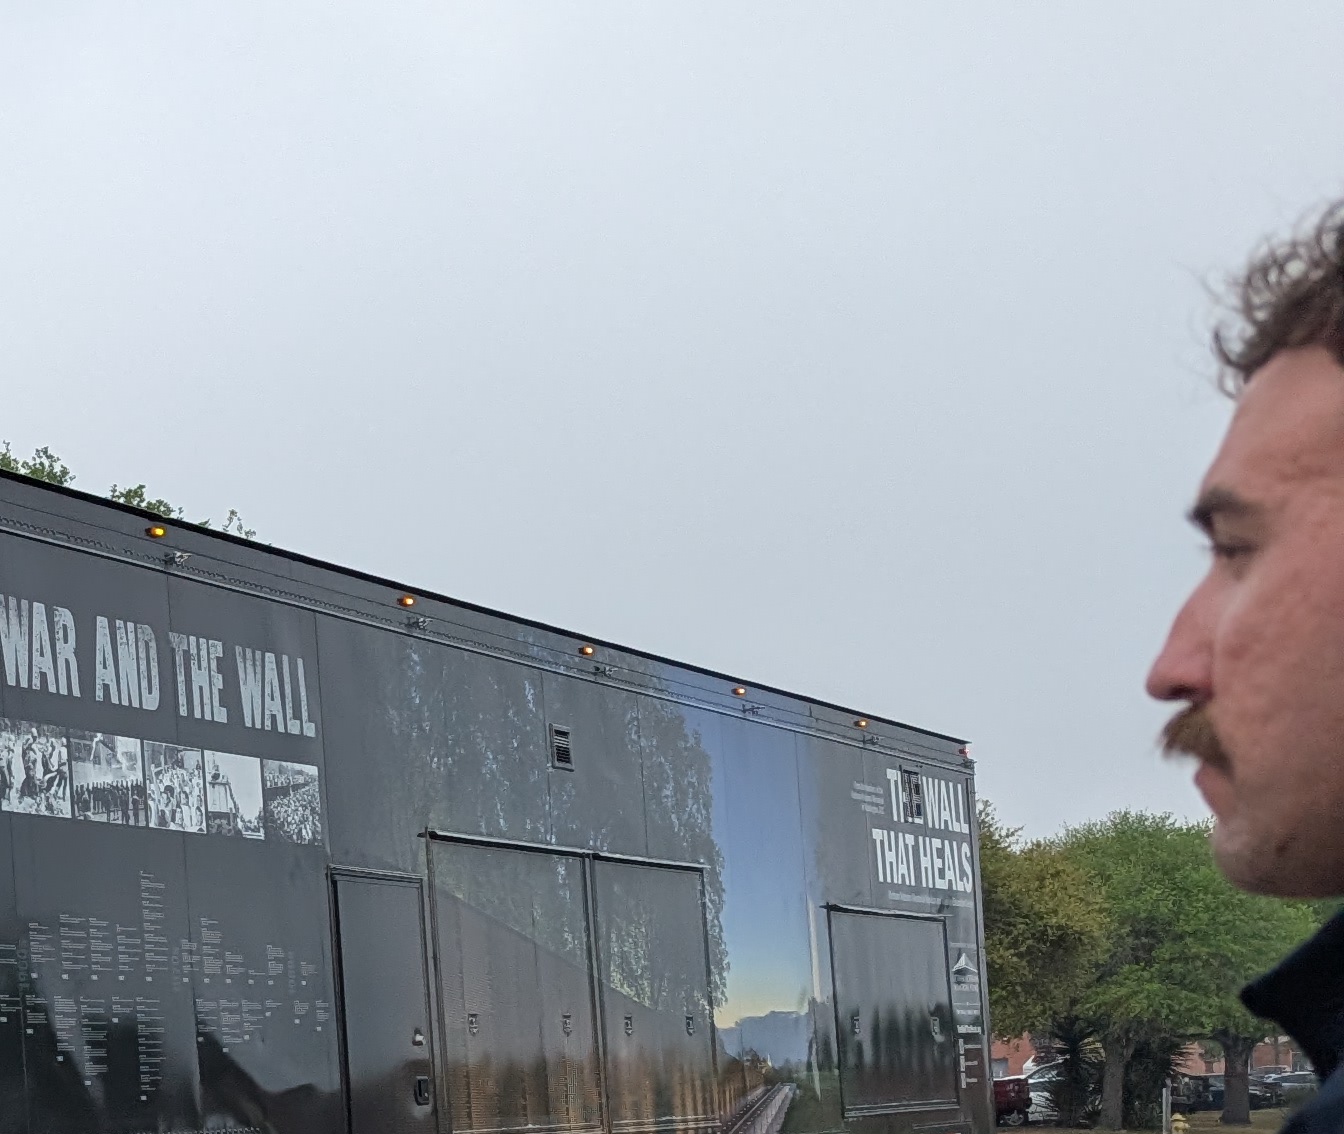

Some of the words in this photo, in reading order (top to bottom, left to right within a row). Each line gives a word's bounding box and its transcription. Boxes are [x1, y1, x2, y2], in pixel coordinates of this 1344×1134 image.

[95, 615, 160, 711] AND
[169, 630, 227, 723] THE
[235, 645, 316, 737] WALL
[922, 776, 970, 834] WALL
[872, 828, 916, 887] THAT
[918, 835, 973, 893] HEALS
